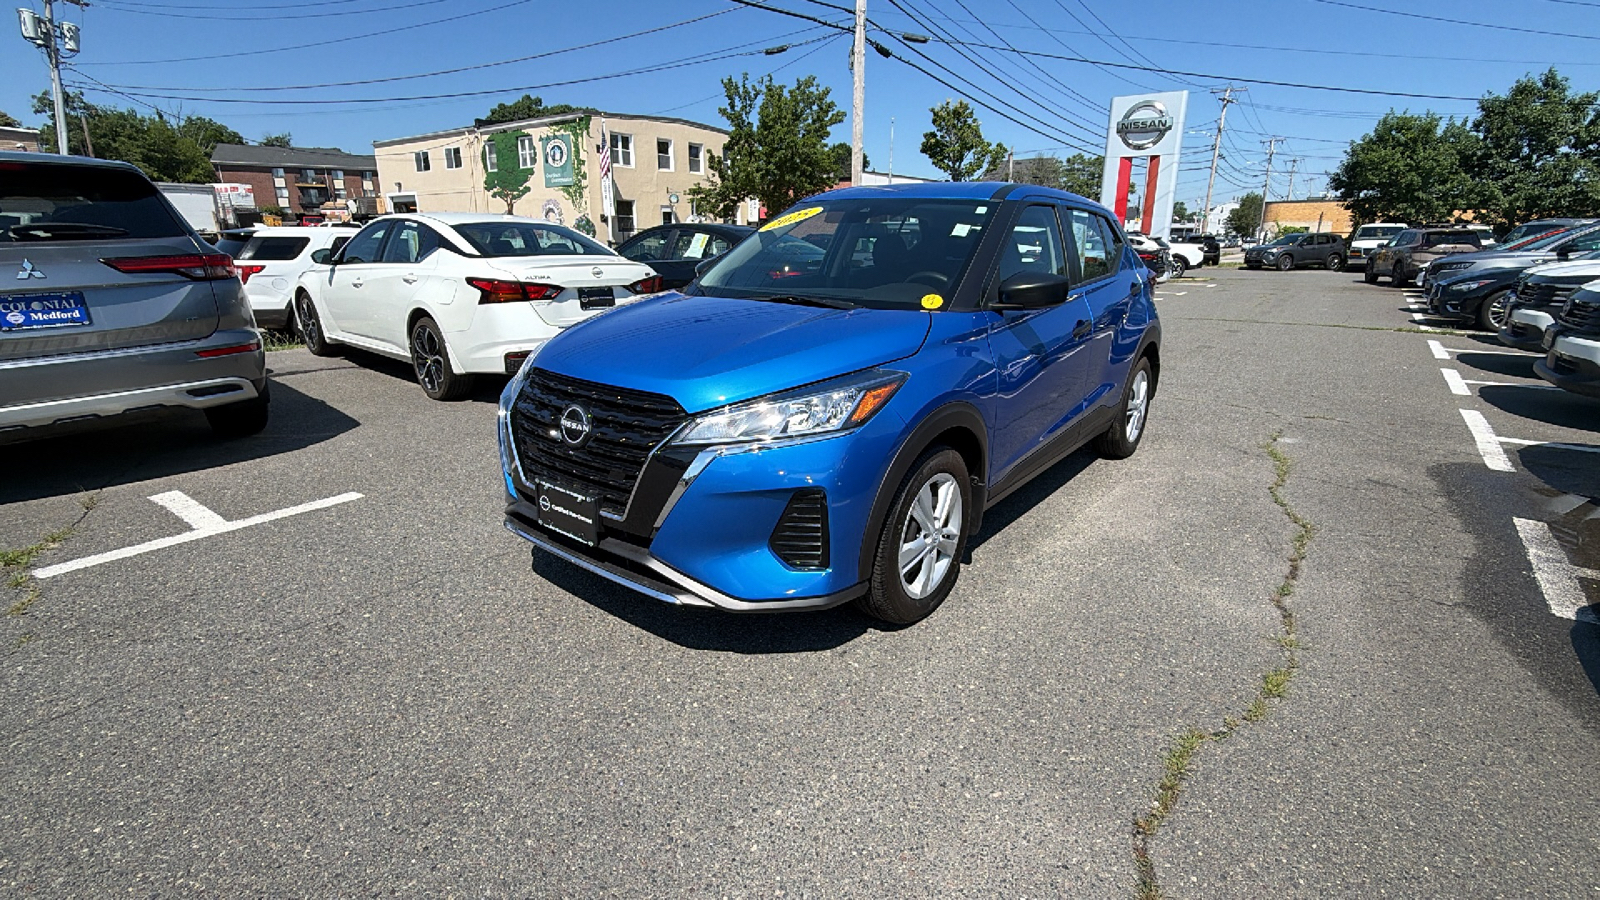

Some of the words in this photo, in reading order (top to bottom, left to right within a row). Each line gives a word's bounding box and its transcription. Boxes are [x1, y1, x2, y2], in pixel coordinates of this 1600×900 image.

[1121, 119, 1167, 131] NISSAN
[0, 299, 81, 313] COLONIAL
[30, 309, 81, 321] Medford
[561, 419, 589, 432] NISSAN
